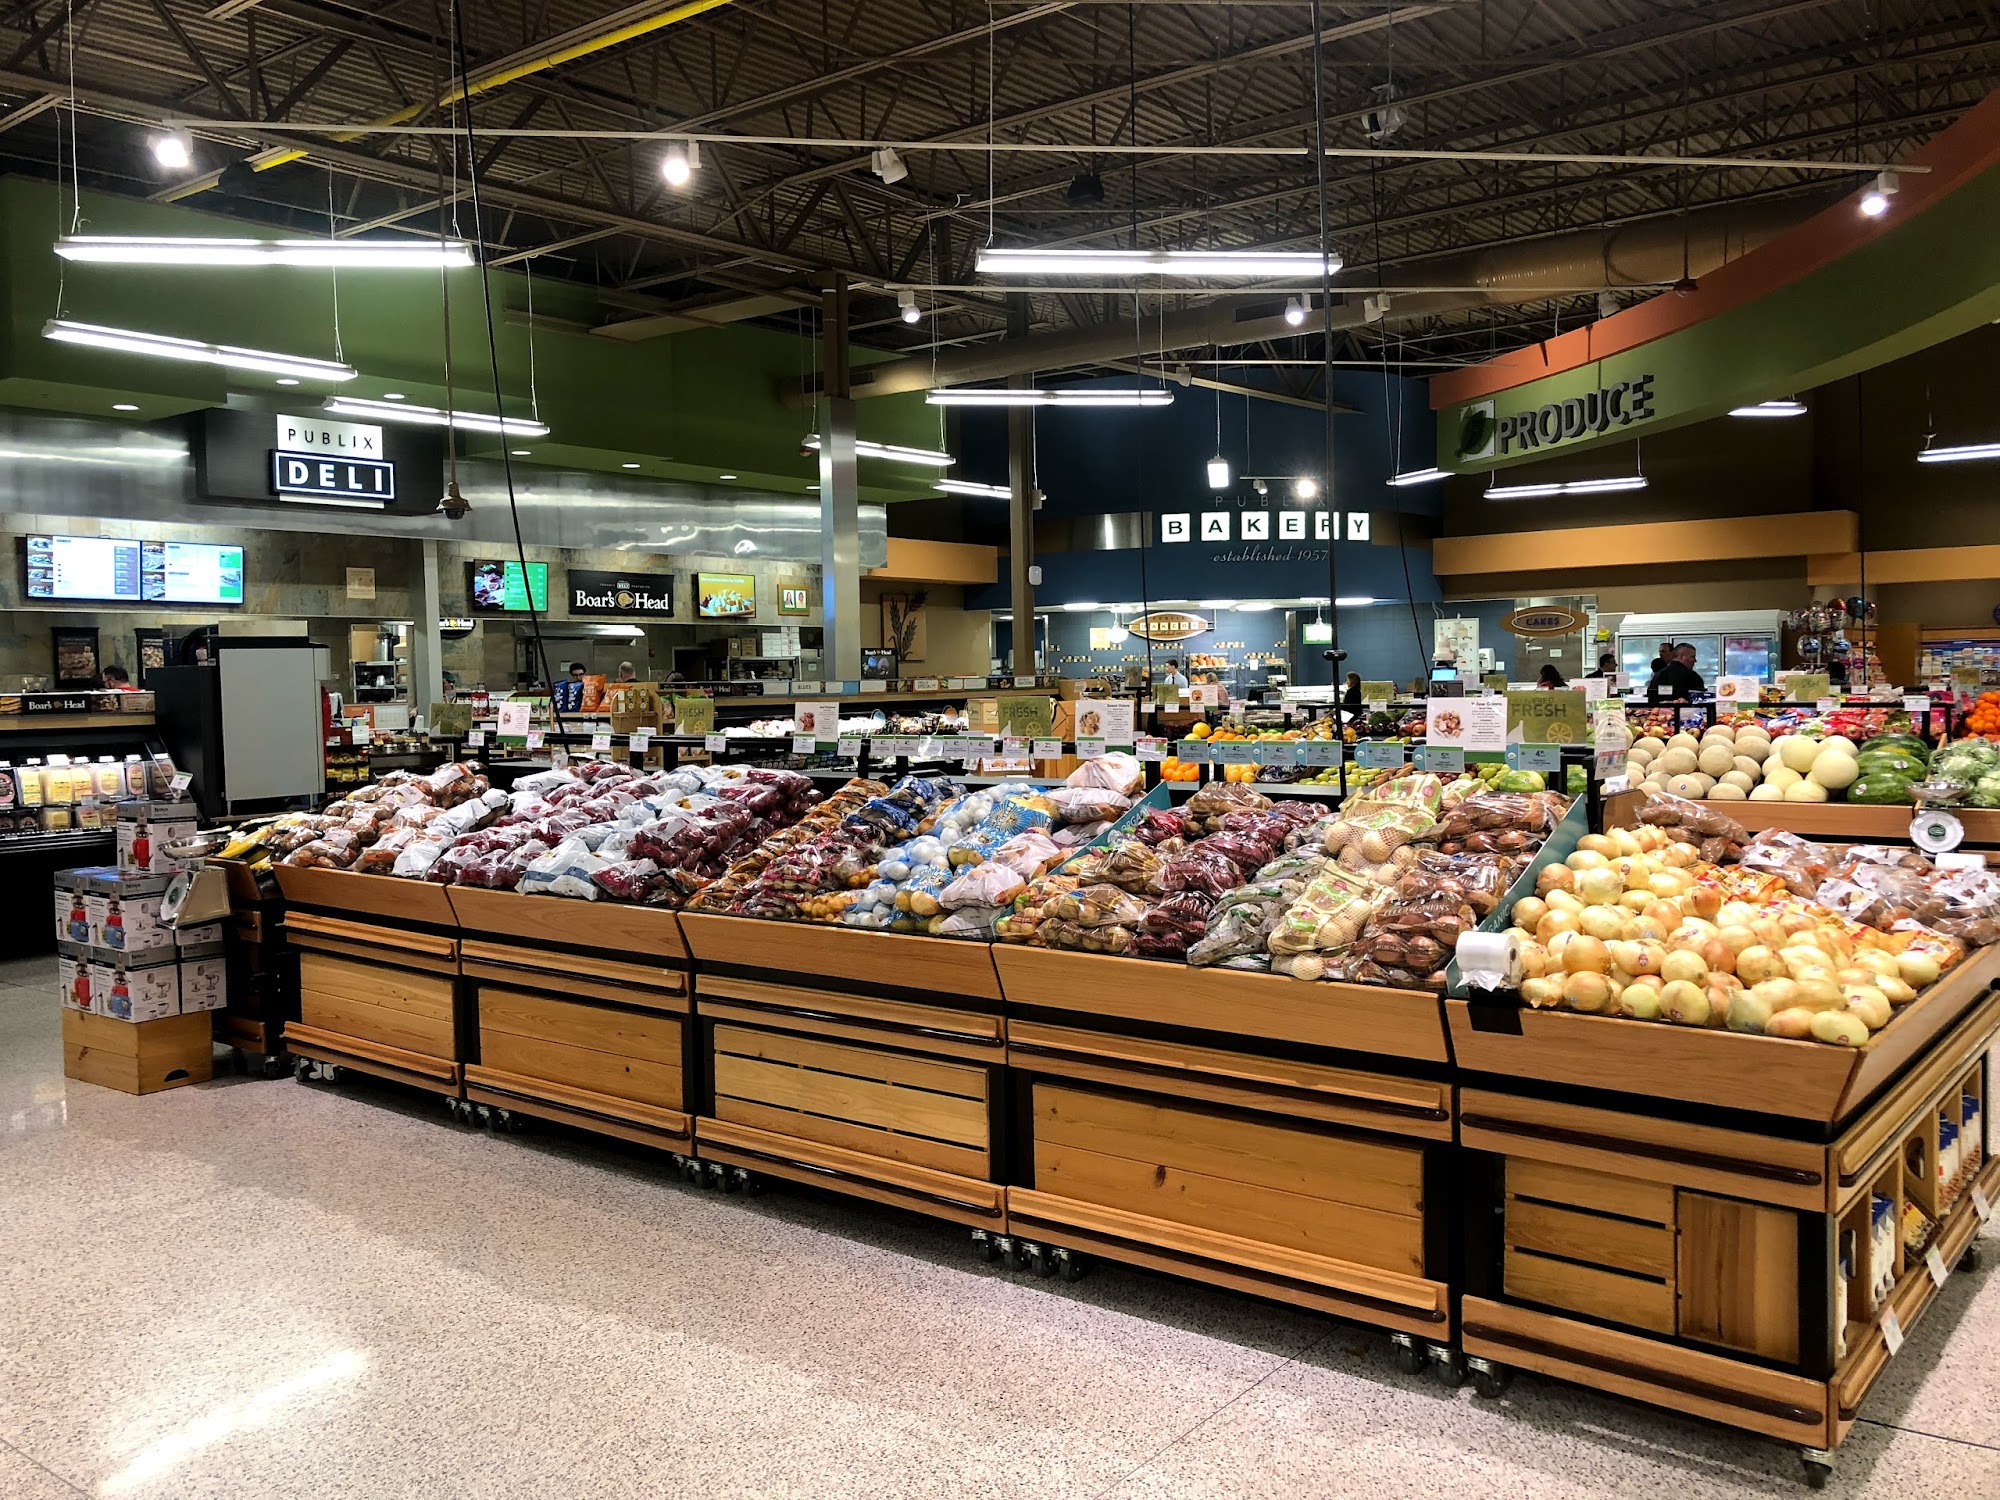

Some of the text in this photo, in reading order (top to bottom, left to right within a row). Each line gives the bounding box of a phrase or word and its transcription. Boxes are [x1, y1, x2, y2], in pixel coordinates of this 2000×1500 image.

[1496, 375, 1654, 454] PRODUCE
[288, 428, 373, 450] PUBLIX
[288, 460, 383, 491] DELI
[1215, 496, 1326, 507] PUBLX
[1212, 544, 1328, 563] established 1957
[575, 590, 669, 610] Boar's Head
[1526, 617, 1560, 626] CAKES
[28, 700, 85, 710] Boar's Head
[679, 708, 705, 717] FRESH
[1002, 707, 1038, 718] FRESH
[1511, 704, 1567, 717] FRESH
[1487, 903, 1511, 932] GANIC
